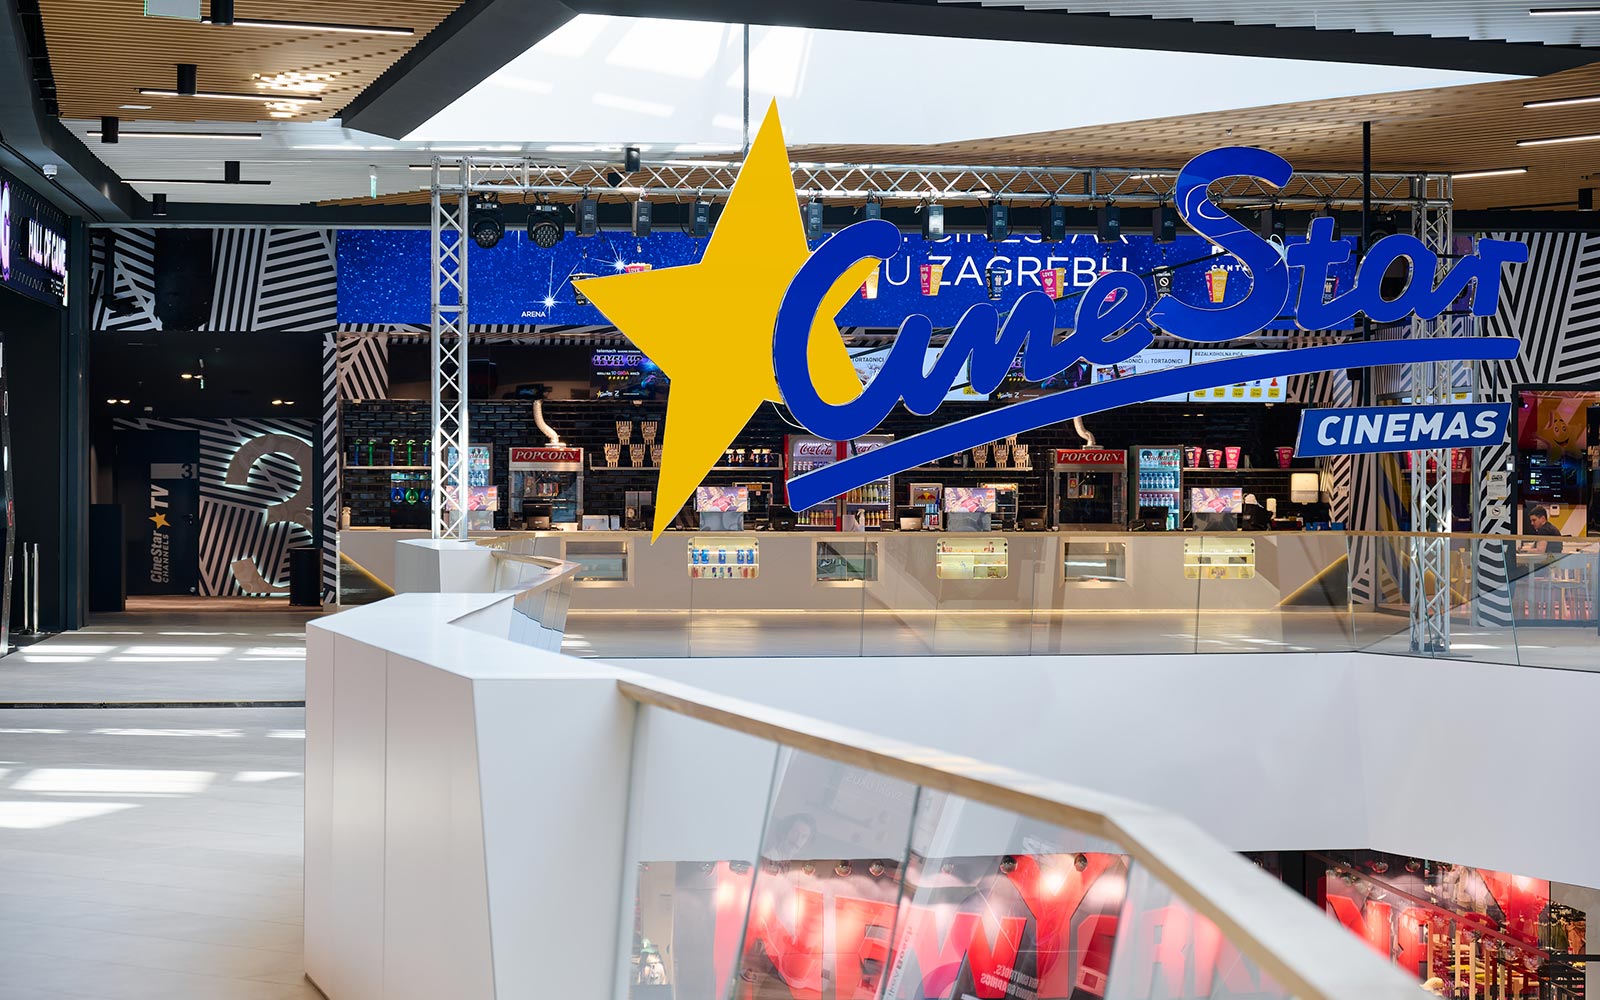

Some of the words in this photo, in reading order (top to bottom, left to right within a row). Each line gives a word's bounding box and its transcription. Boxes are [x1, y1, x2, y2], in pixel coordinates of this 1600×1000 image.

[774, 146, 1527, 438] CineStar
[594, 354, 625, 367] LEVEL
[626, 354, 643, 367] UP
[1317, 410, 1499, 446] CINEMAS
[515, 451, 577, 461] POPCORN
[1060, 452, 1121, 461] POPCORN
[181, 463, 193, 480] 3
[150, 483, 169, 510] TV
[150, 529, 162, 584] CineStar
